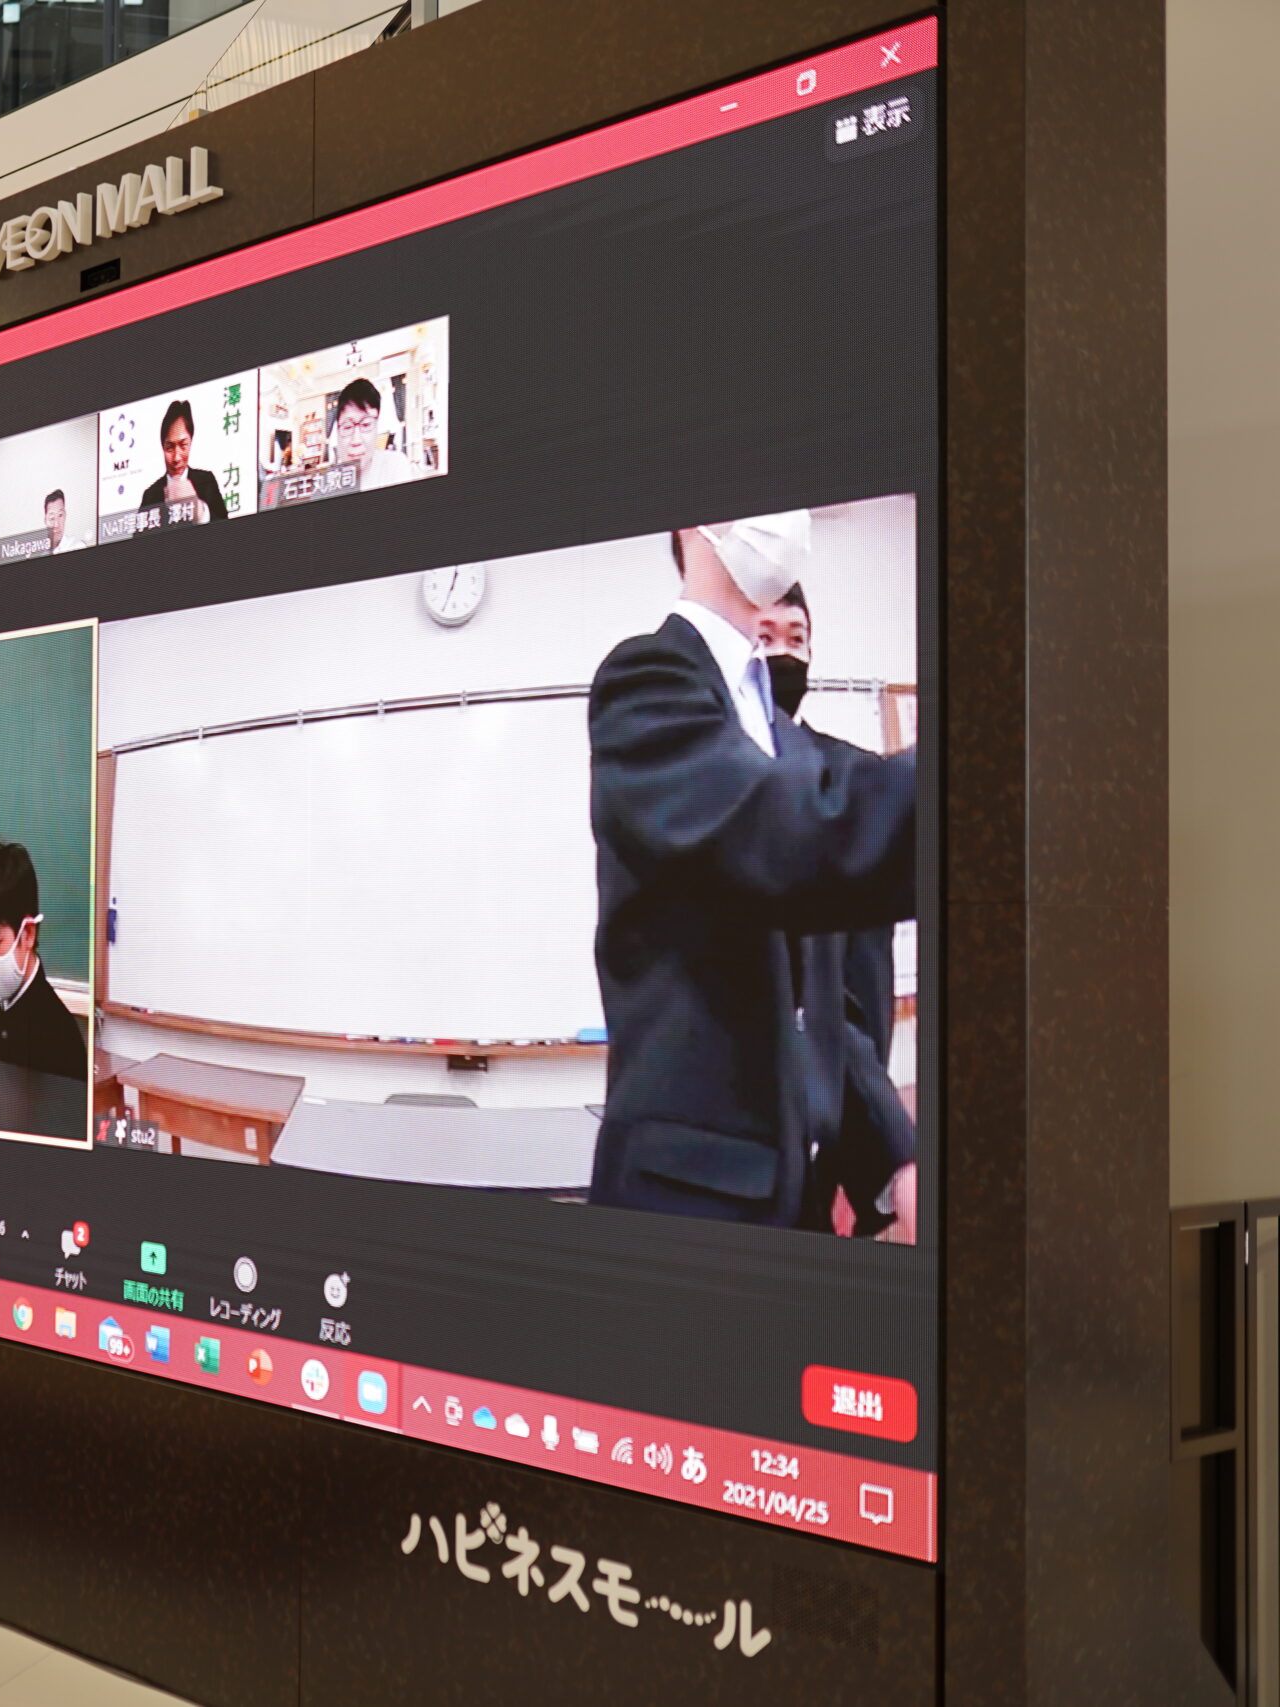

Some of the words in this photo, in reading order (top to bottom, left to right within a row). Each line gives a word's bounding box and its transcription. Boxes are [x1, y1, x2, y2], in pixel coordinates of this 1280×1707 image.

[861, 96, 911, 136] 表示
[96, 146, 223, 238] MALL
[1, 537, 51, 560] Nakagawa
[131, 1127, 156, 1145] stu2
[54, 1267, 87, 1290] チャット
[123, 1279, 185, 1312] 画面の共有
[209, 1296, 282, 1331] レコーディング
[108, 1336, 131, 1357] 99+
[319, 1317, 352, 1346] 反応
[832, 1383, 883, 1422] 退出
[681, 1446, 707, 1484] あ
[751, 1449, 800, 1480] 12:34
[723, 1479, 829, 1525] 2021/04/25
